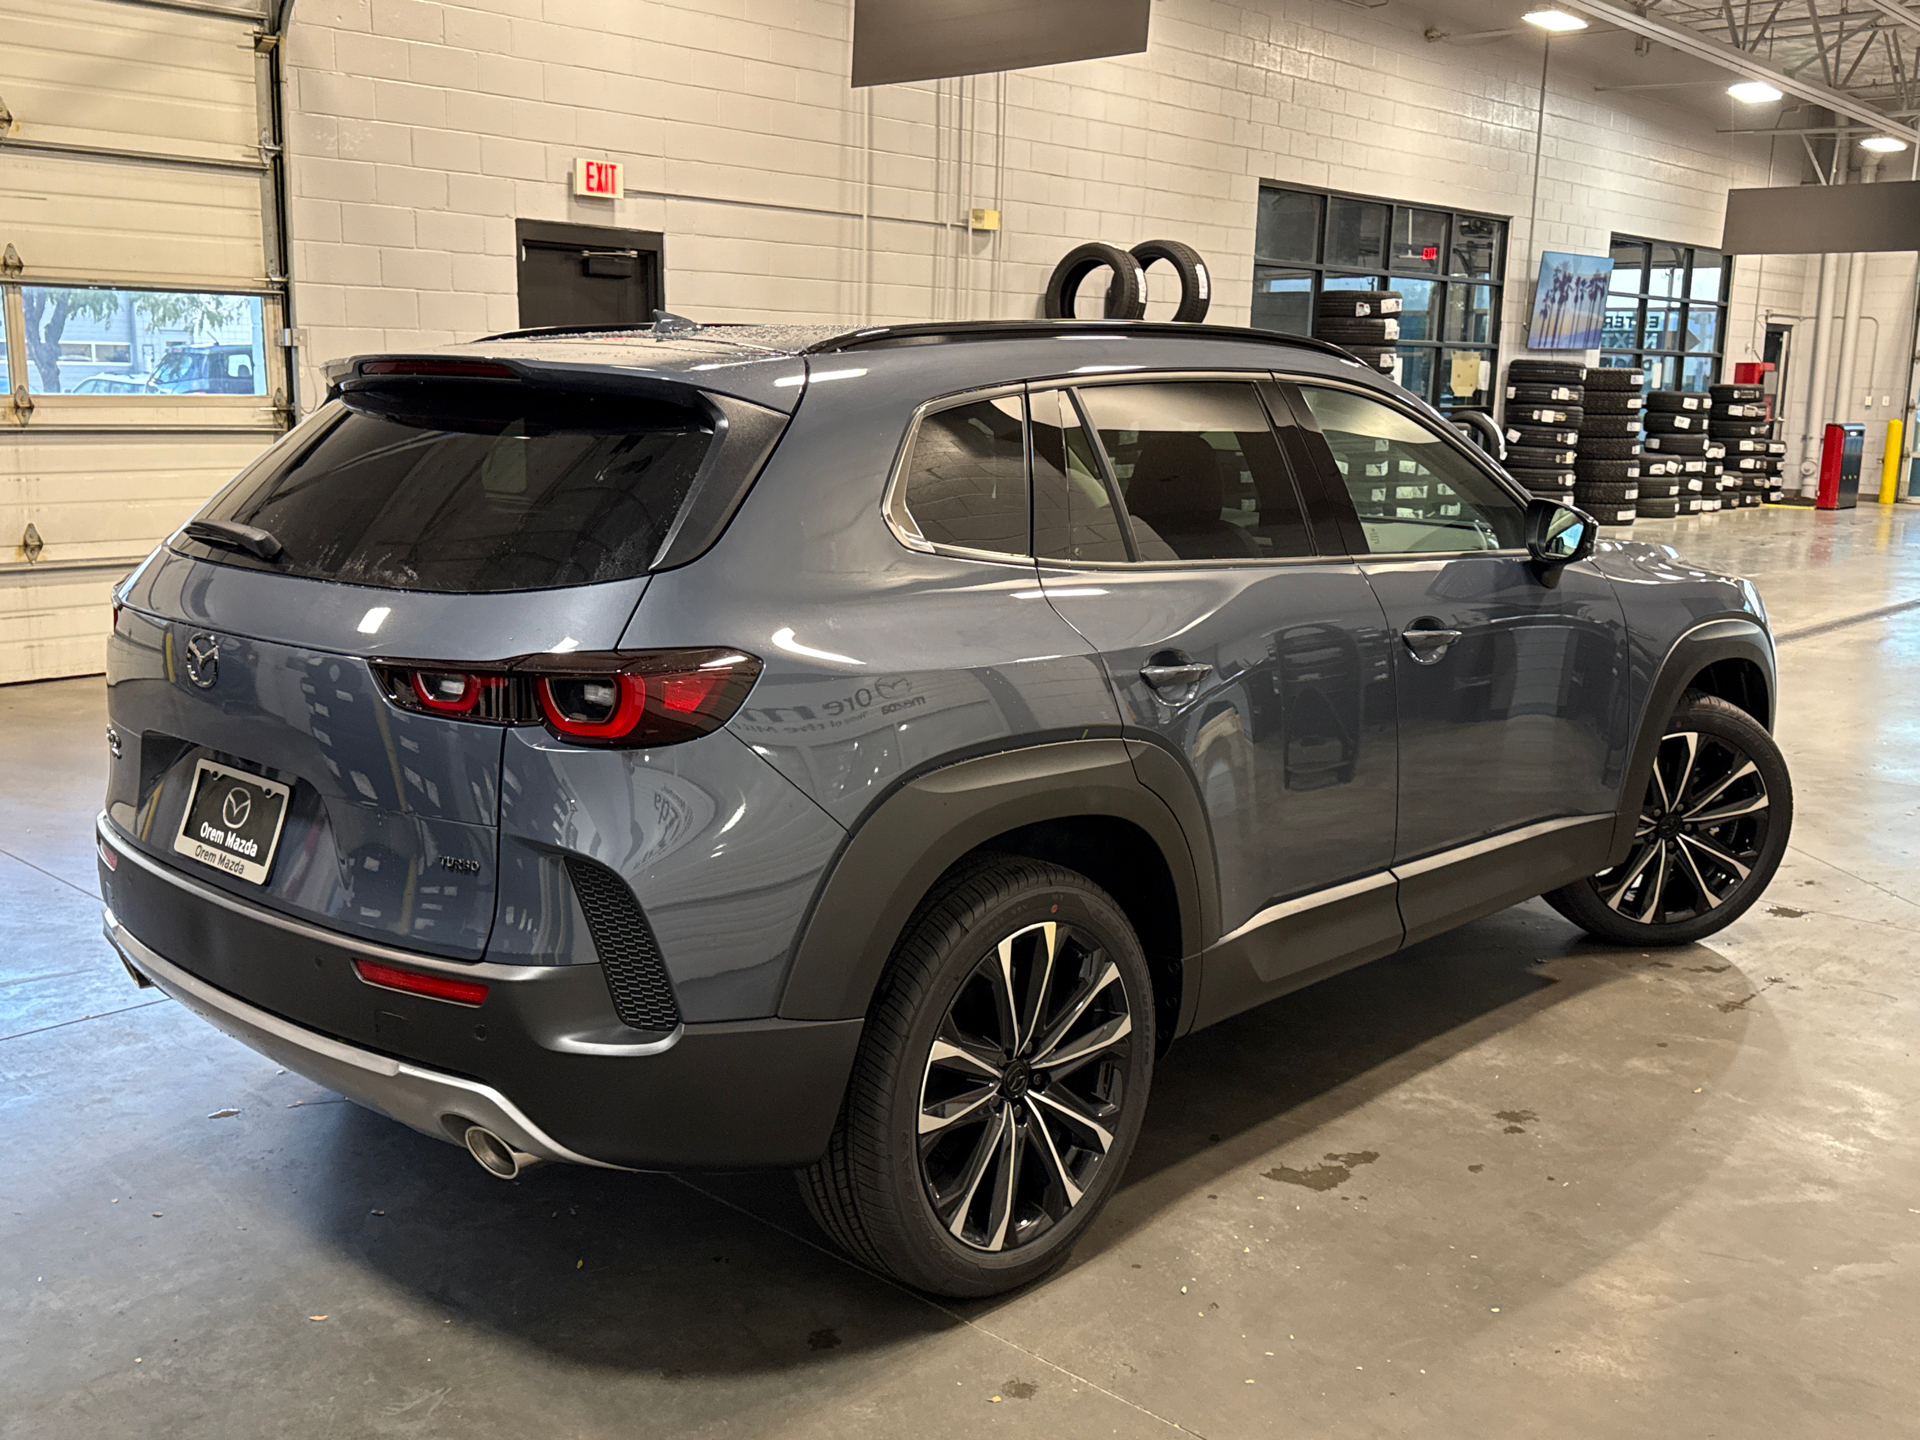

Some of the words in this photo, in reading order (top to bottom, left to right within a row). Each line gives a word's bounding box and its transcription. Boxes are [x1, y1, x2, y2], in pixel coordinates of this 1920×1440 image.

[585, 161, 617, 194] EXIT
[200, 821, 225, 845] Orem
[225, 831, 258, 857] Mazda
[195, 844, 217, 864] Orem
[217, 853, 245, 875] Mazda
